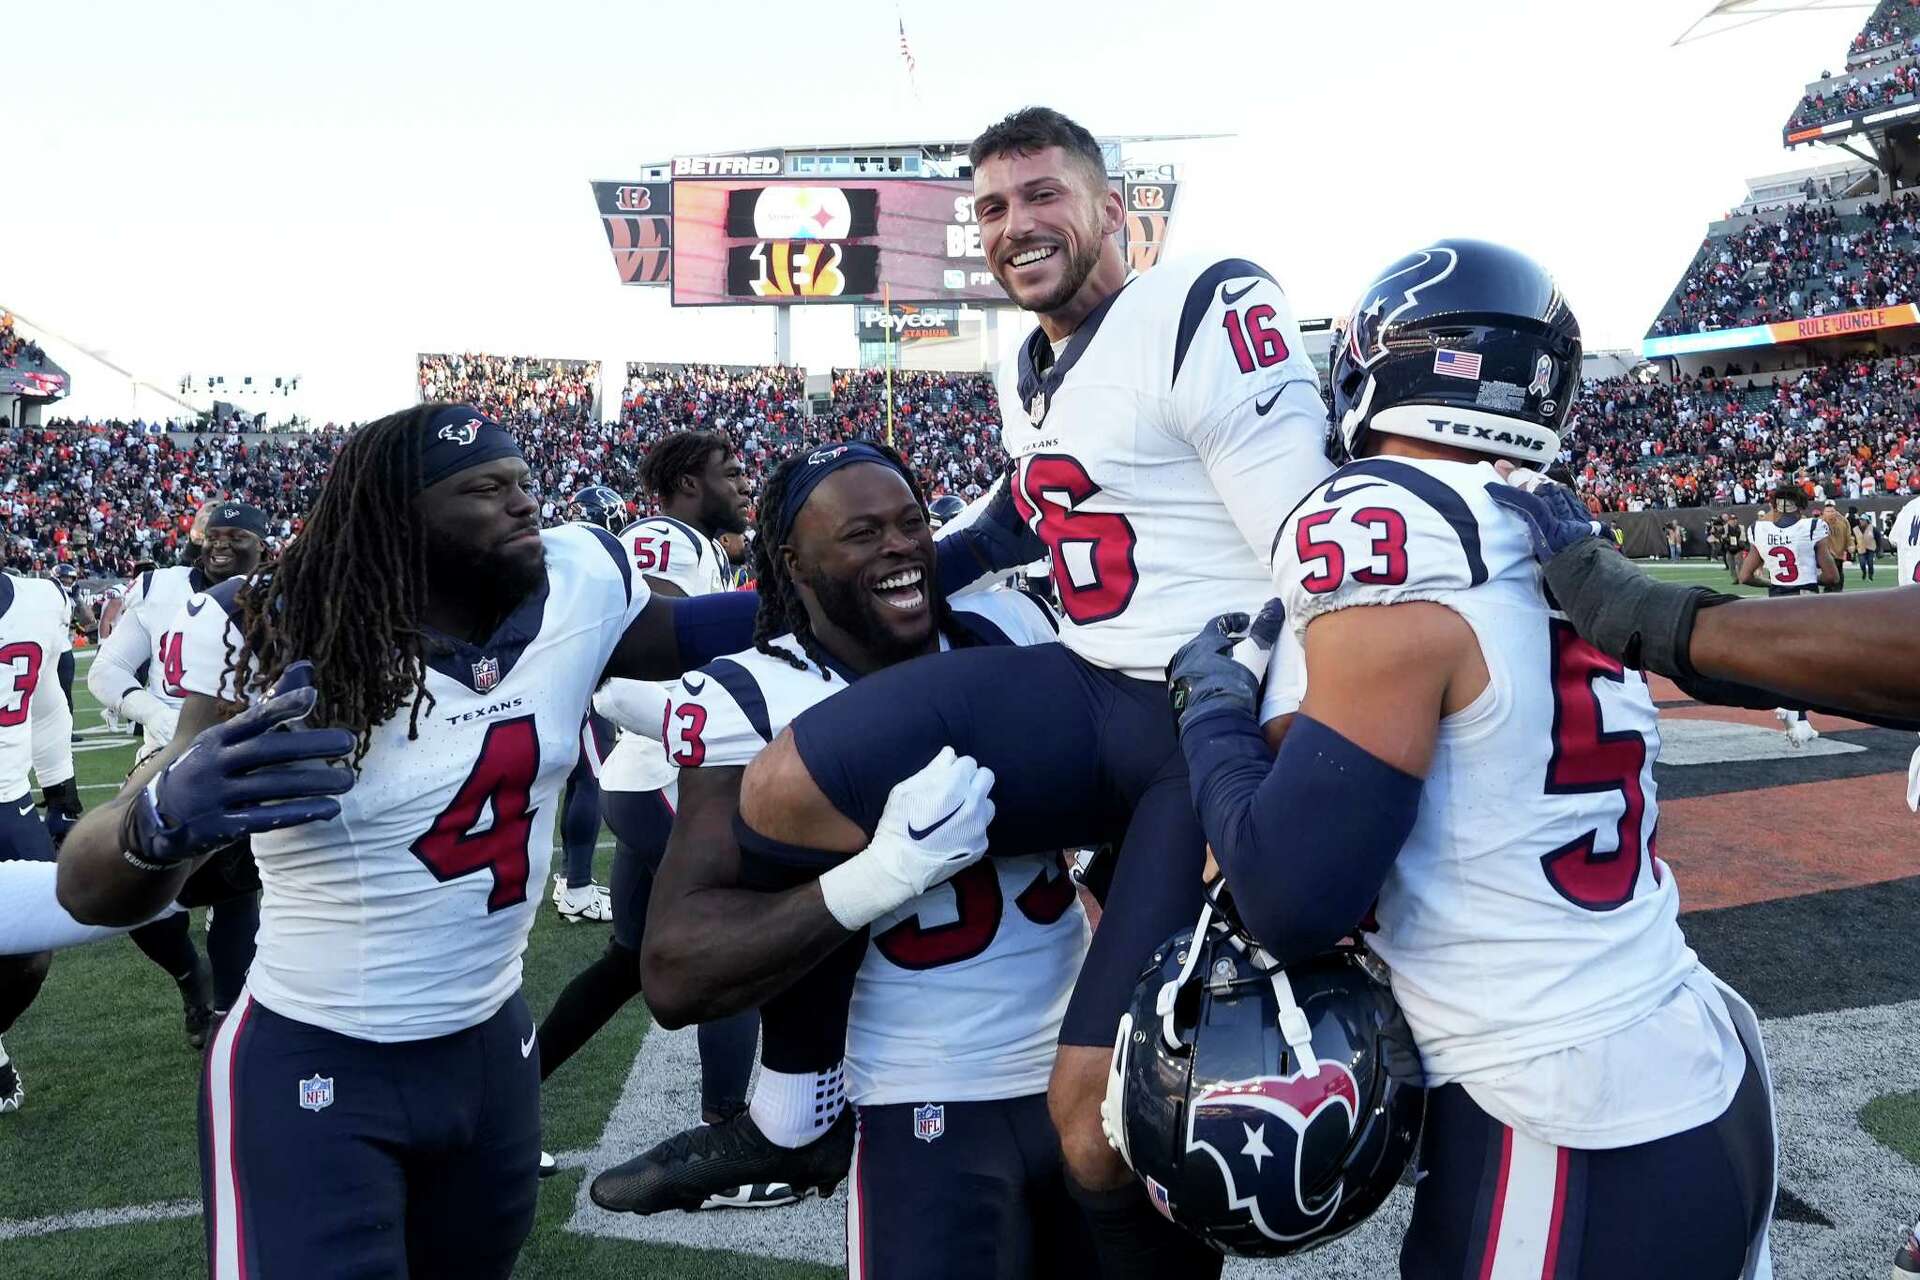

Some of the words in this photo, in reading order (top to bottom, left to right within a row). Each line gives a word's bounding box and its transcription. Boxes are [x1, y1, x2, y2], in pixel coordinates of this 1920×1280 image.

[674, 156, 780, 175] BETFRED
[864, 309, 948, 332] Paycor
[1798, 319, 1832, 337] RULE
[1834, 312, 1887, 331] JUNGLE
[1222, 304, 1290, 374] 16
[1427, 418, 1546, 452] TEXANS
[634, 537, 672, 572] 51
[1296, 507, 1409, 595] 53
[1768, 534, 1791, 546] DELL
[1768, 546, 1799, 583] 3
[159, 631, 192, 698] 4
[445, 697, 523, 726] TEXANS
[662, 698, 708, 767] 3
[1540, 617, 1661, 912] 5
[408, 714, 540, 915] 4
[305, 1090, 330, 1104] NFL
[919, 1119, 940, 1134] NFL
